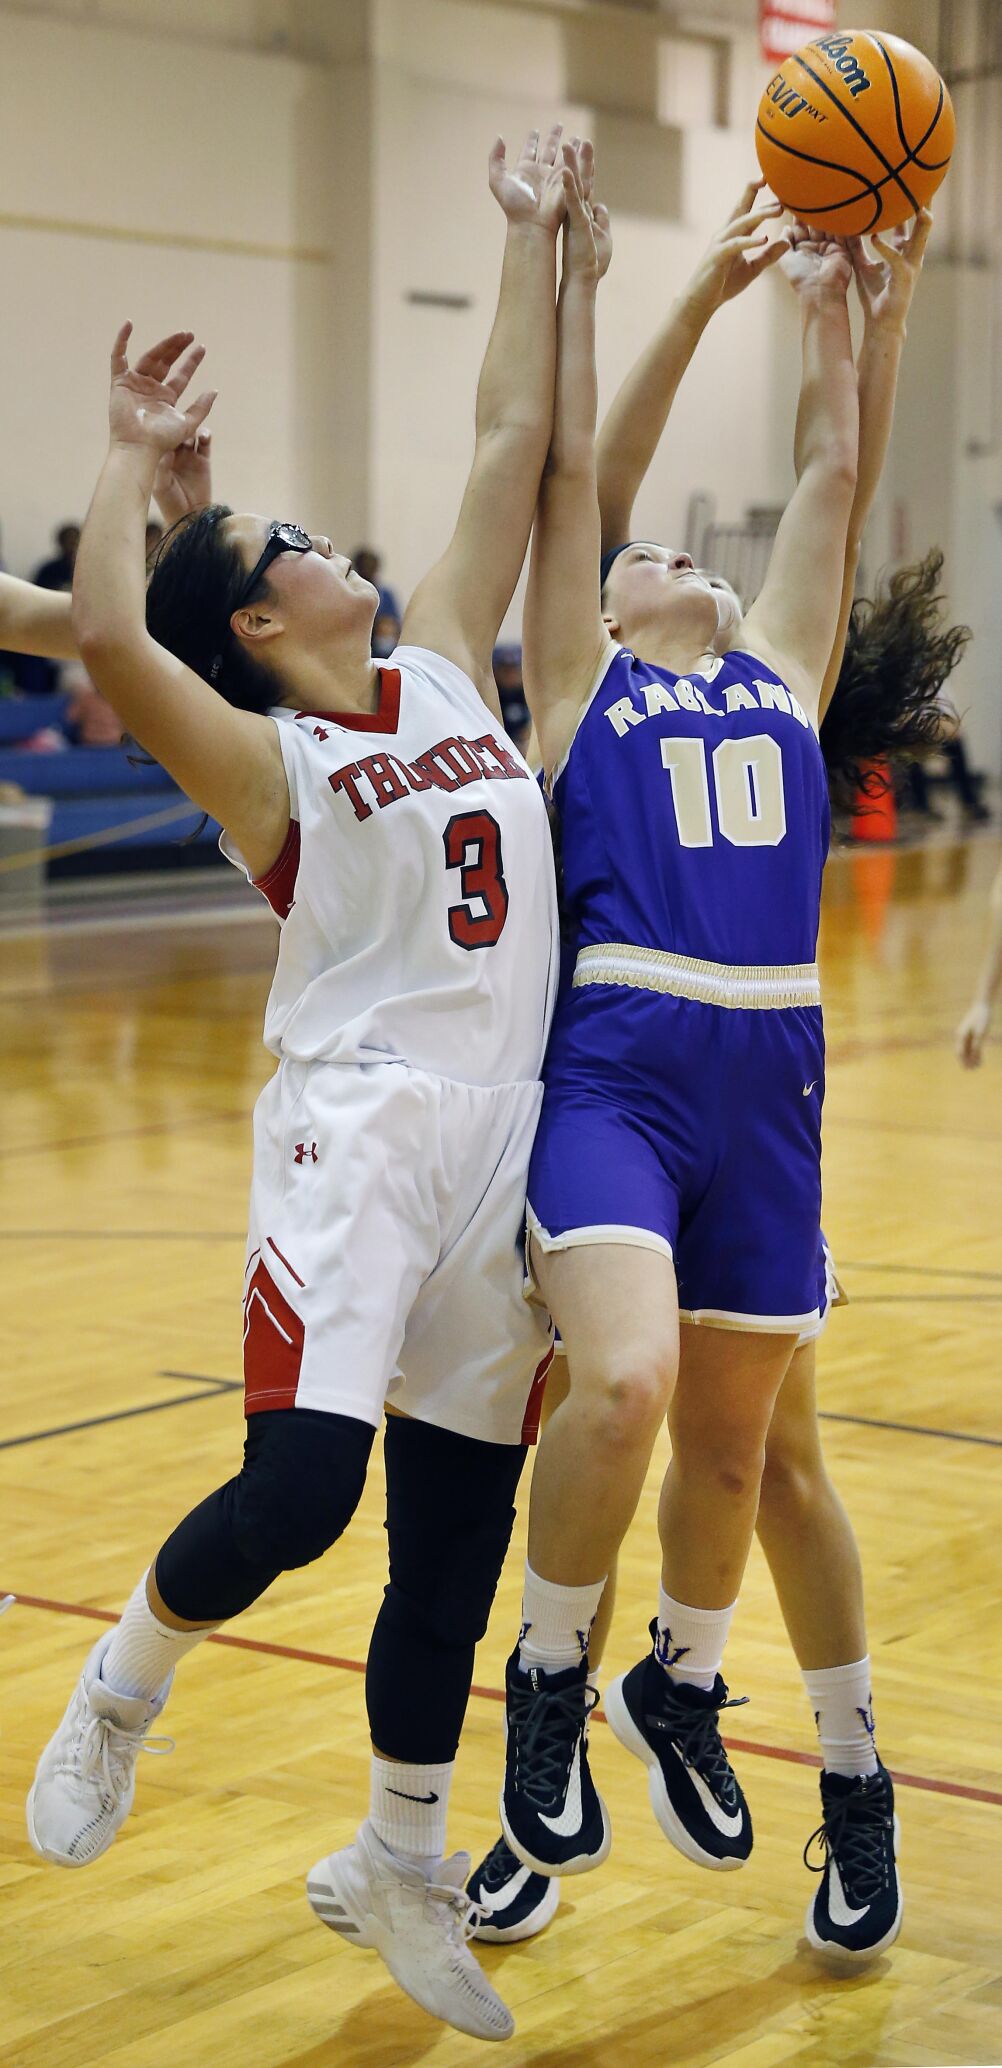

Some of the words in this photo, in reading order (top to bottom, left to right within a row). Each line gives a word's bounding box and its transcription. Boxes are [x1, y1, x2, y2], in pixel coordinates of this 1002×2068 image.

[766, 74, 808, 118] EVO
[805, 105, 829, 123] NXT
[660, 734, 787, 848] 10
[443, 809, 509, 951] 3
